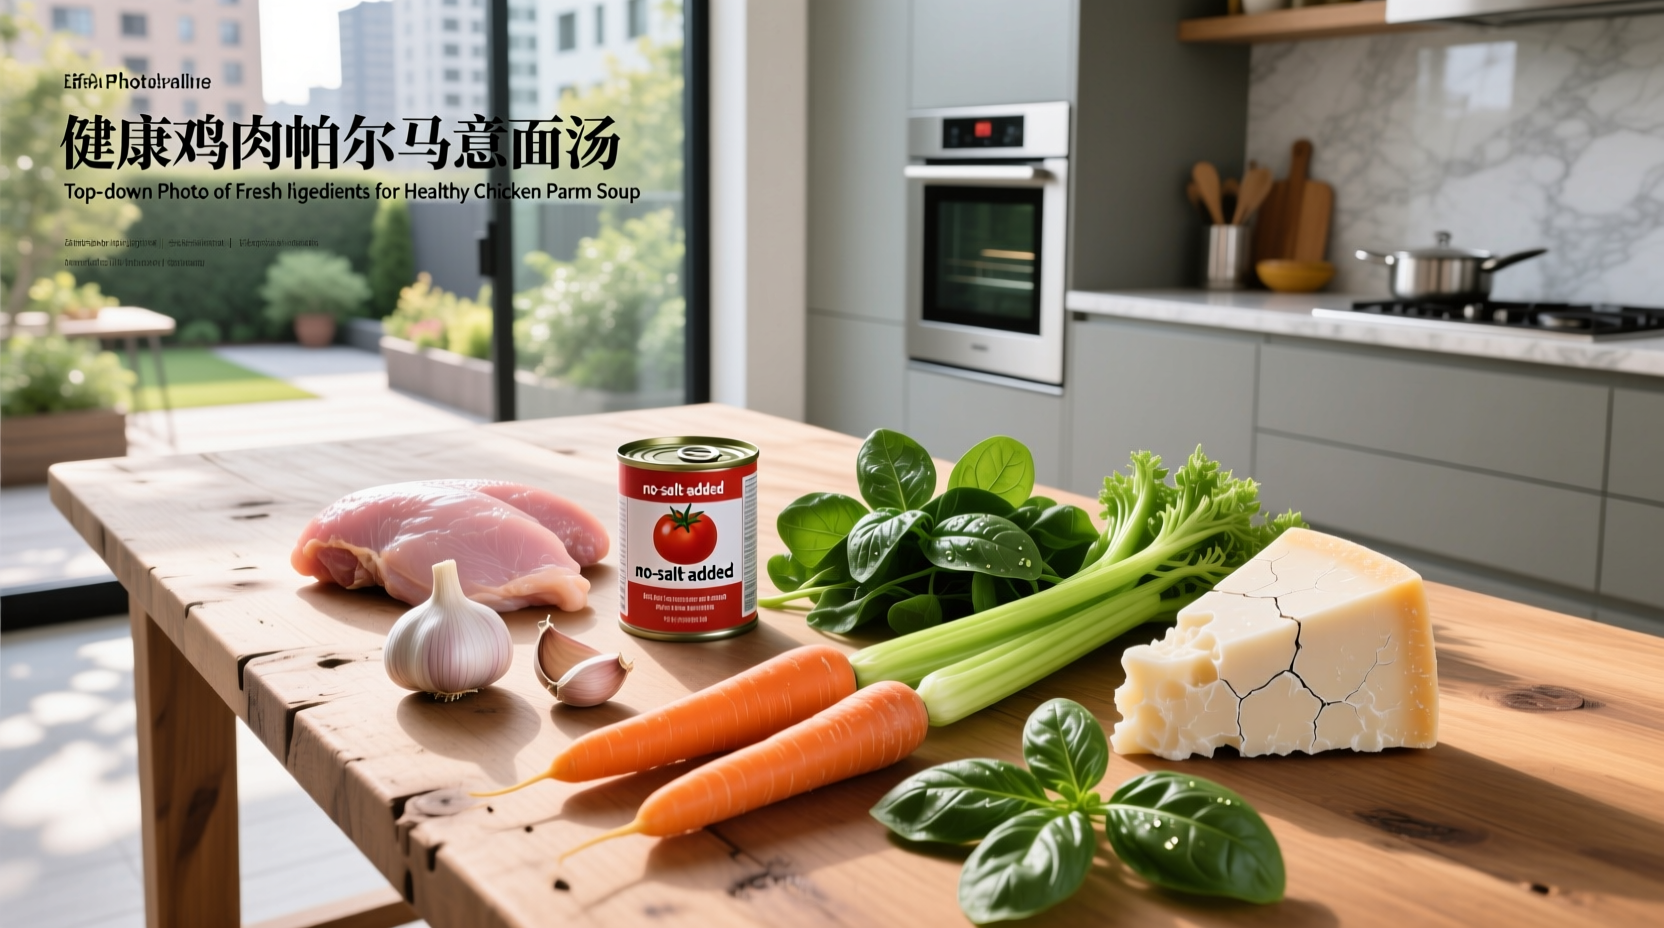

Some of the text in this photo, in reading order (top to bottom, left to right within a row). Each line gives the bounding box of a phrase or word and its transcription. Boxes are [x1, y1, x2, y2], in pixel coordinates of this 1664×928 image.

[643, 480, 725, 496] no-salt added
[635, 562, 734, 581] no-salt added
